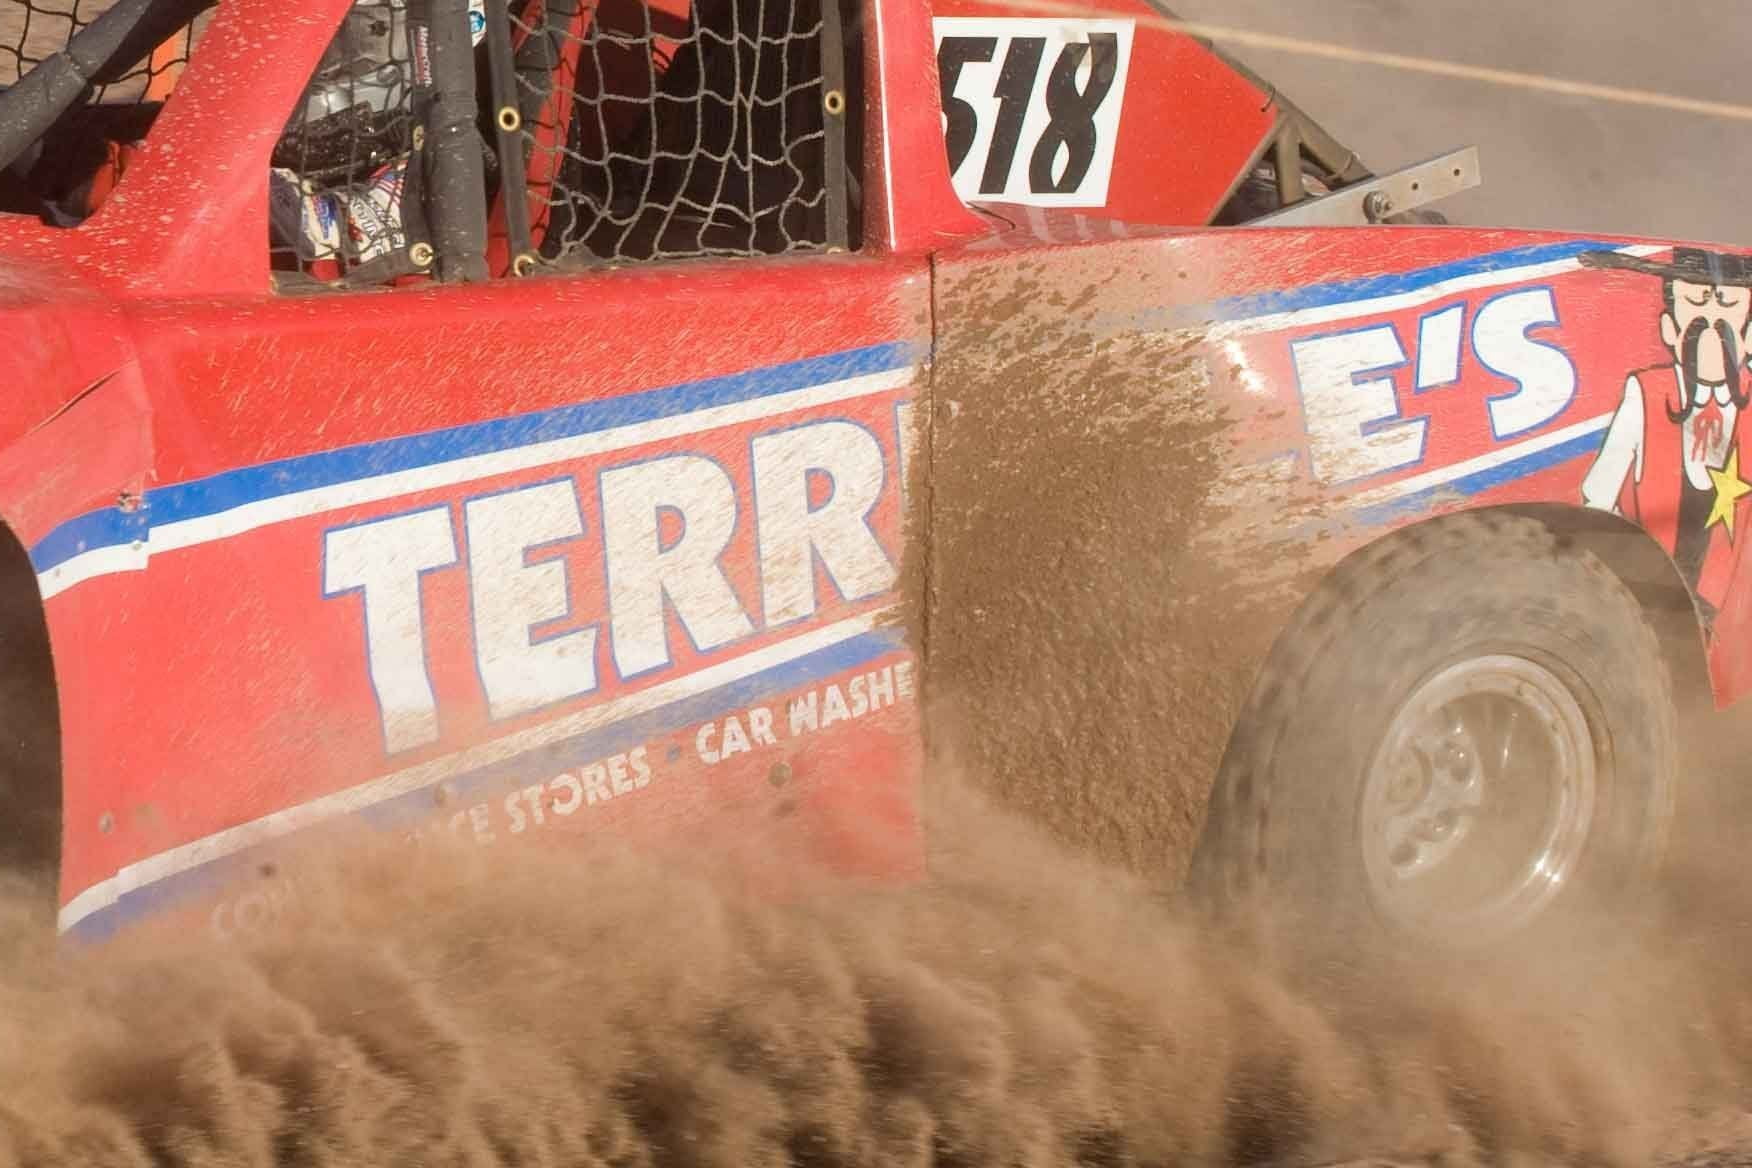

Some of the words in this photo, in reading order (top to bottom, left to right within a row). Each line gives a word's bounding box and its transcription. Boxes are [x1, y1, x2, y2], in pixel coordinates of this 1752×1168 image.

[938, 32, 1119, 195] 518
[503, 745, 653, 833] STORES
[696, 706, 777, 765] CAR
